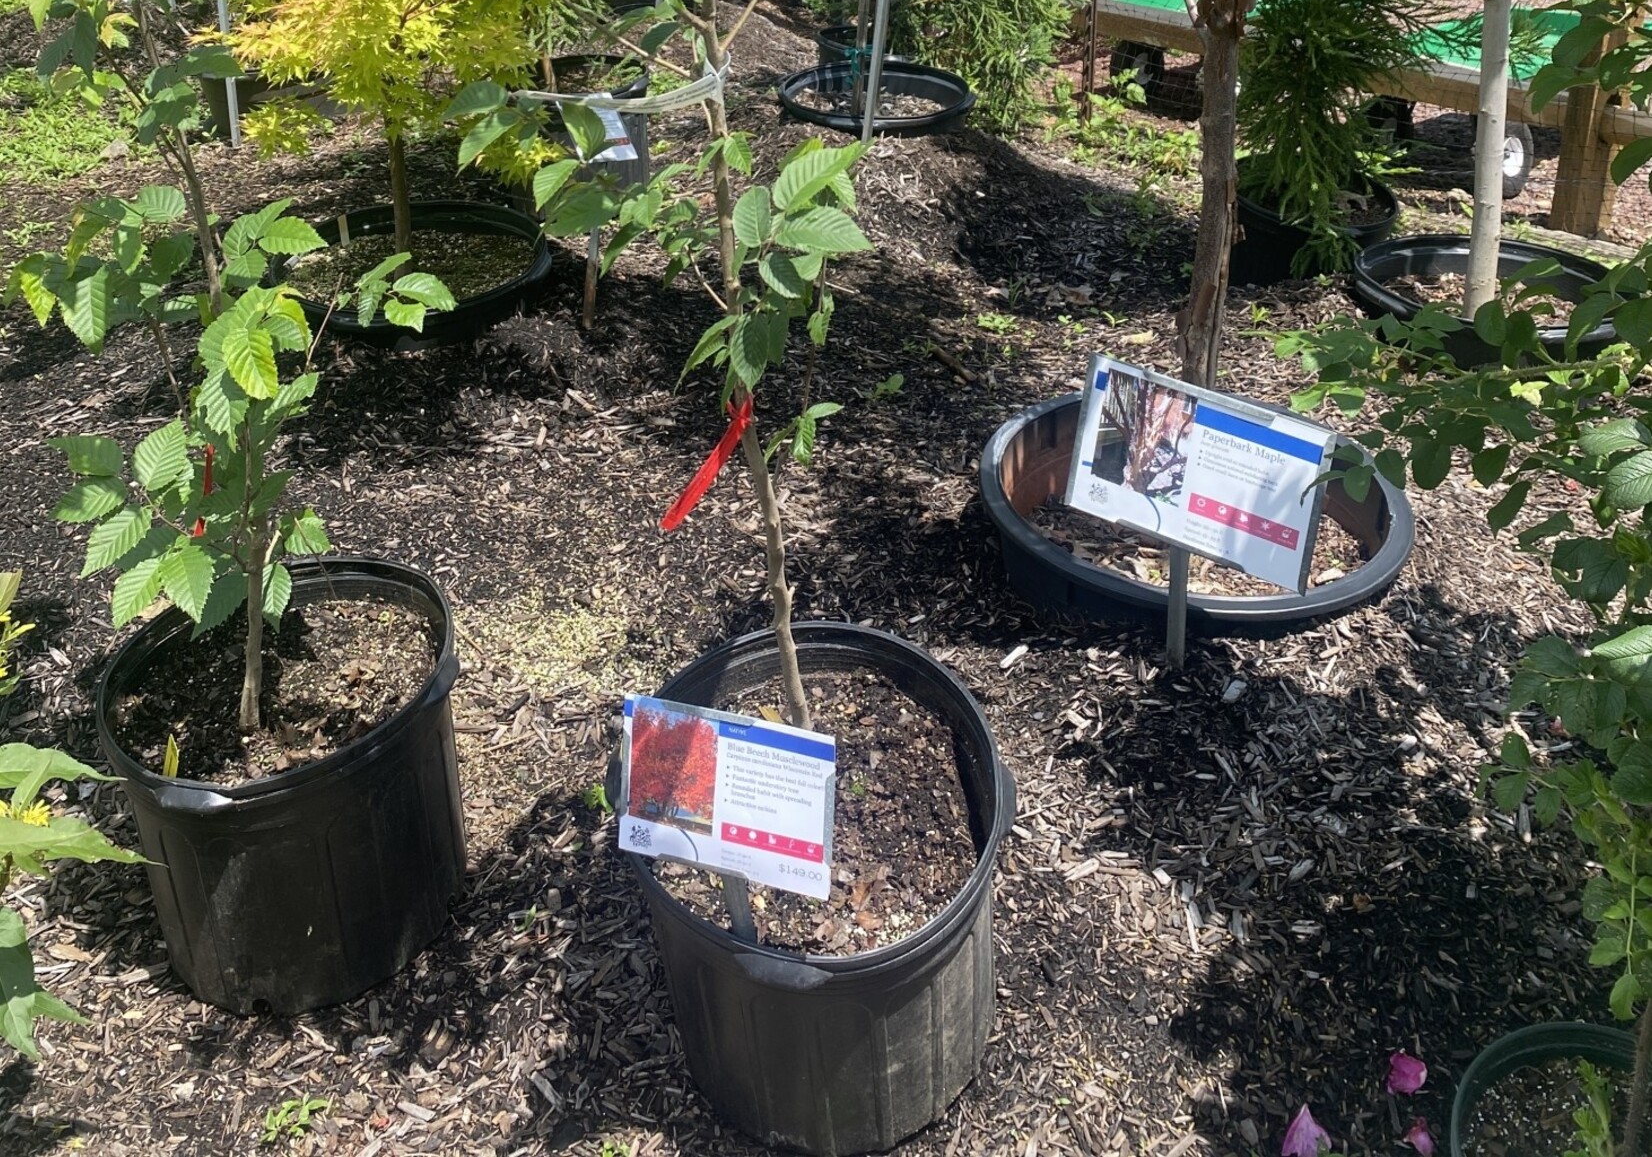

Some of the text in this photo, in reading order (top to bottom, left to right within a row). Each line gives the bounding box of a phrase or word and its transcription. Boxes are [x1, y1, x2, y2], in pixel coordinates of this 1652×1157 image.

[1202, 429, 1286, 465] Paperbark Maple
[728, 727, 747, 736] NATIVE
[727, 742, 821, 770] Blue Beech Musclewood
[778, 863, 822, 882] $149.00
